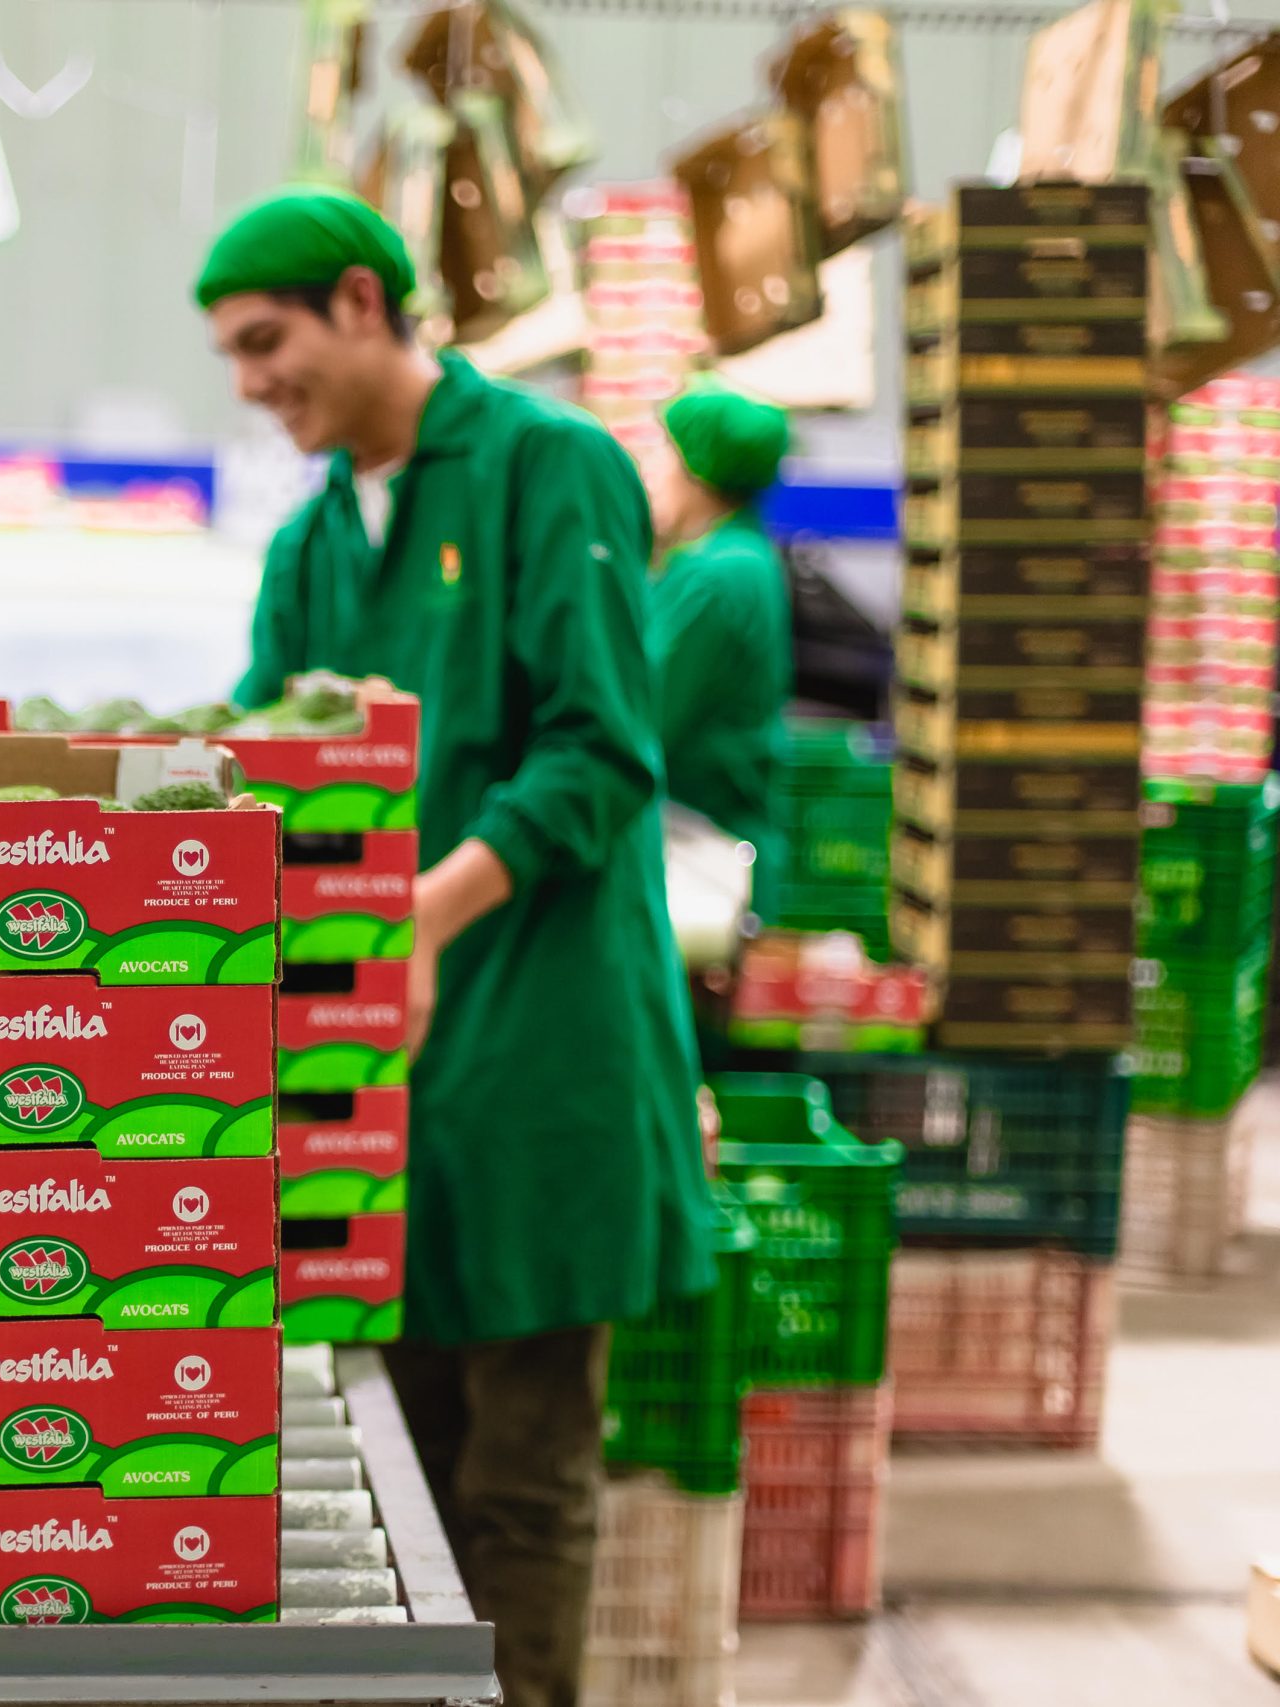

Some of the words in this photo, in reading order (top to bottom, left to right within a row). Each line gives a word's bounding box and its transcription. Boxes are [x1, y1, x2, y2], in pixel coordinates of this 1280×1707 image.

[144, 898, 190, 907] PRODUCE
[195, 898, 208, 906] OF
[6, 914, 71, 935] westfalia
[119, 960, 188, 973] AVOCATS
[141, 1072, 187, 1080] PRODUCE
[191, 1072, 205, 1080] OF
[4, 1088, 68, 1109] westfalia
[116, 1134, 185, 1146] AVOCATS
[144, 1244, 190, 1252] PRODUCE
[212, 1243, 238, 1251] PERU
[8, 1261, 73, 1281] westfalia
[120, 1305, 189, 1317] AVOCATS
[146, 1413, 192, 1421] PRODUCE
[196, 1412, 210, 1420] OF
[11, 1429, 75, 1449] westfalia
[122, 1473, 191, 1485] AVOCATS
[146, 1582, 191, 1590] PRODUCE
